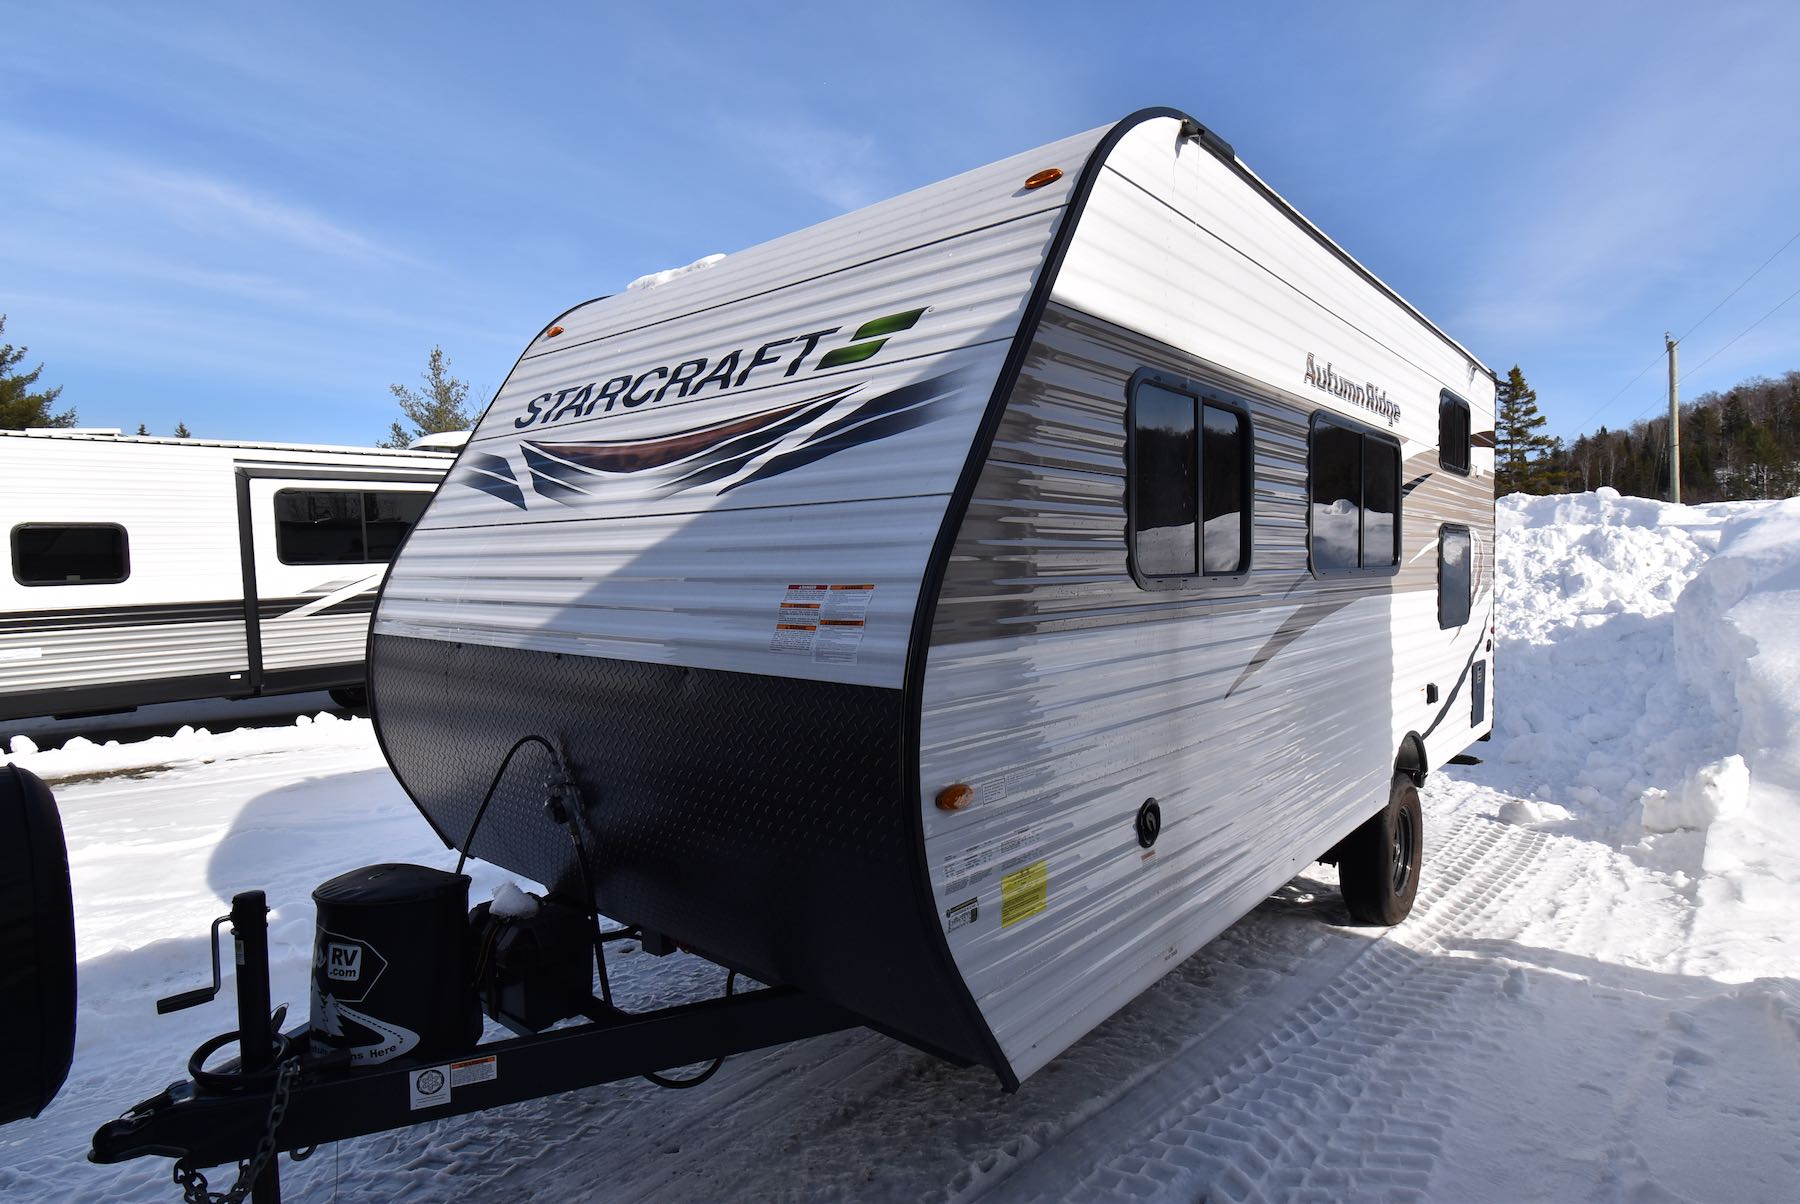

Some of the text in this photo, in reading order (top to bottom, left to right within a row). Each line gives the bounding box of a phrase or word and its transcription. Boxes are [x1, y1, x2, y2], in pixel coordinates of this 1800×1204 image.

[514, 326, 843, 429] STARCRAFT
[331, 947, 359, 967] RV
[329, 968, 357, 978] .com
[369, 1044, 397, 1059] Here
